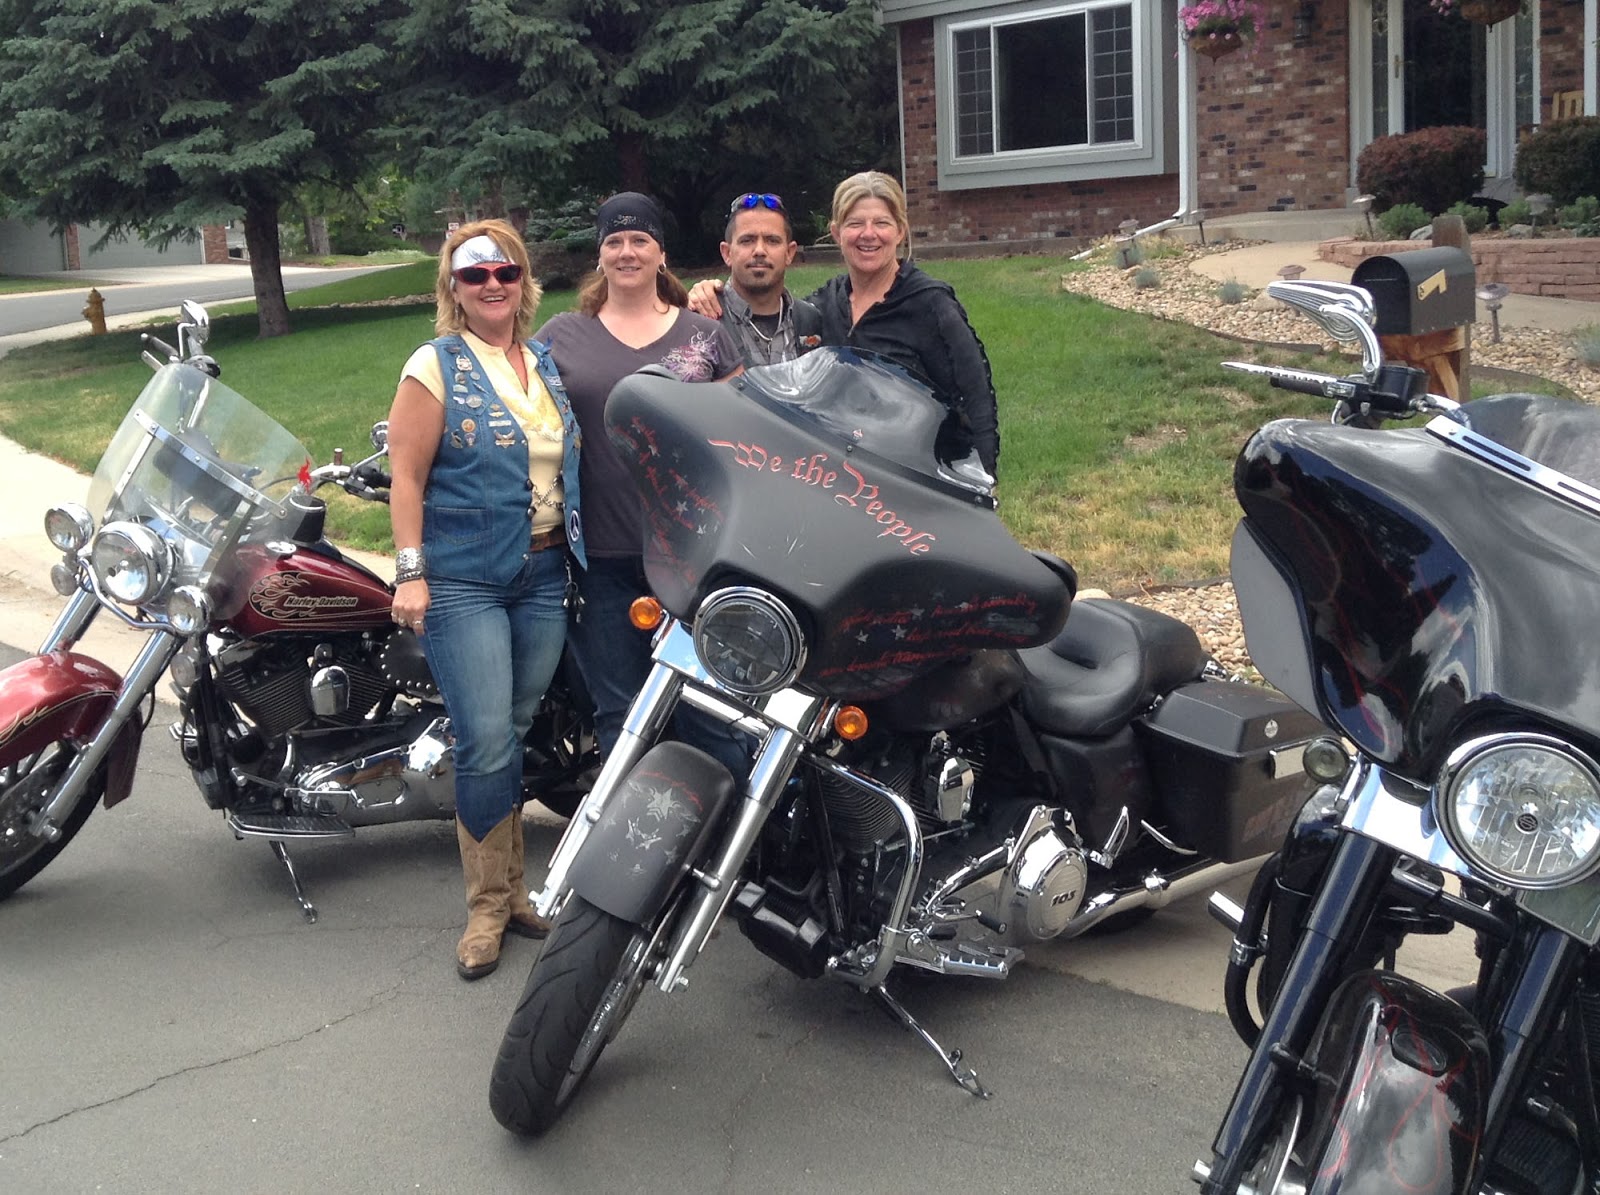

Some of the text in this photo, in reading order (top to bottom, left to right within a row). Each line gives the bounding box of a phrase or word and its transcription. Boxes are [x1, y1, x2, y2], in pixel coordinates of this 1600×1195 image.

[707, 438, 936, 556] We the People
[284, 595, 358, 608] Harley-Davidson
[1051, 889, 1077, 908] 103
